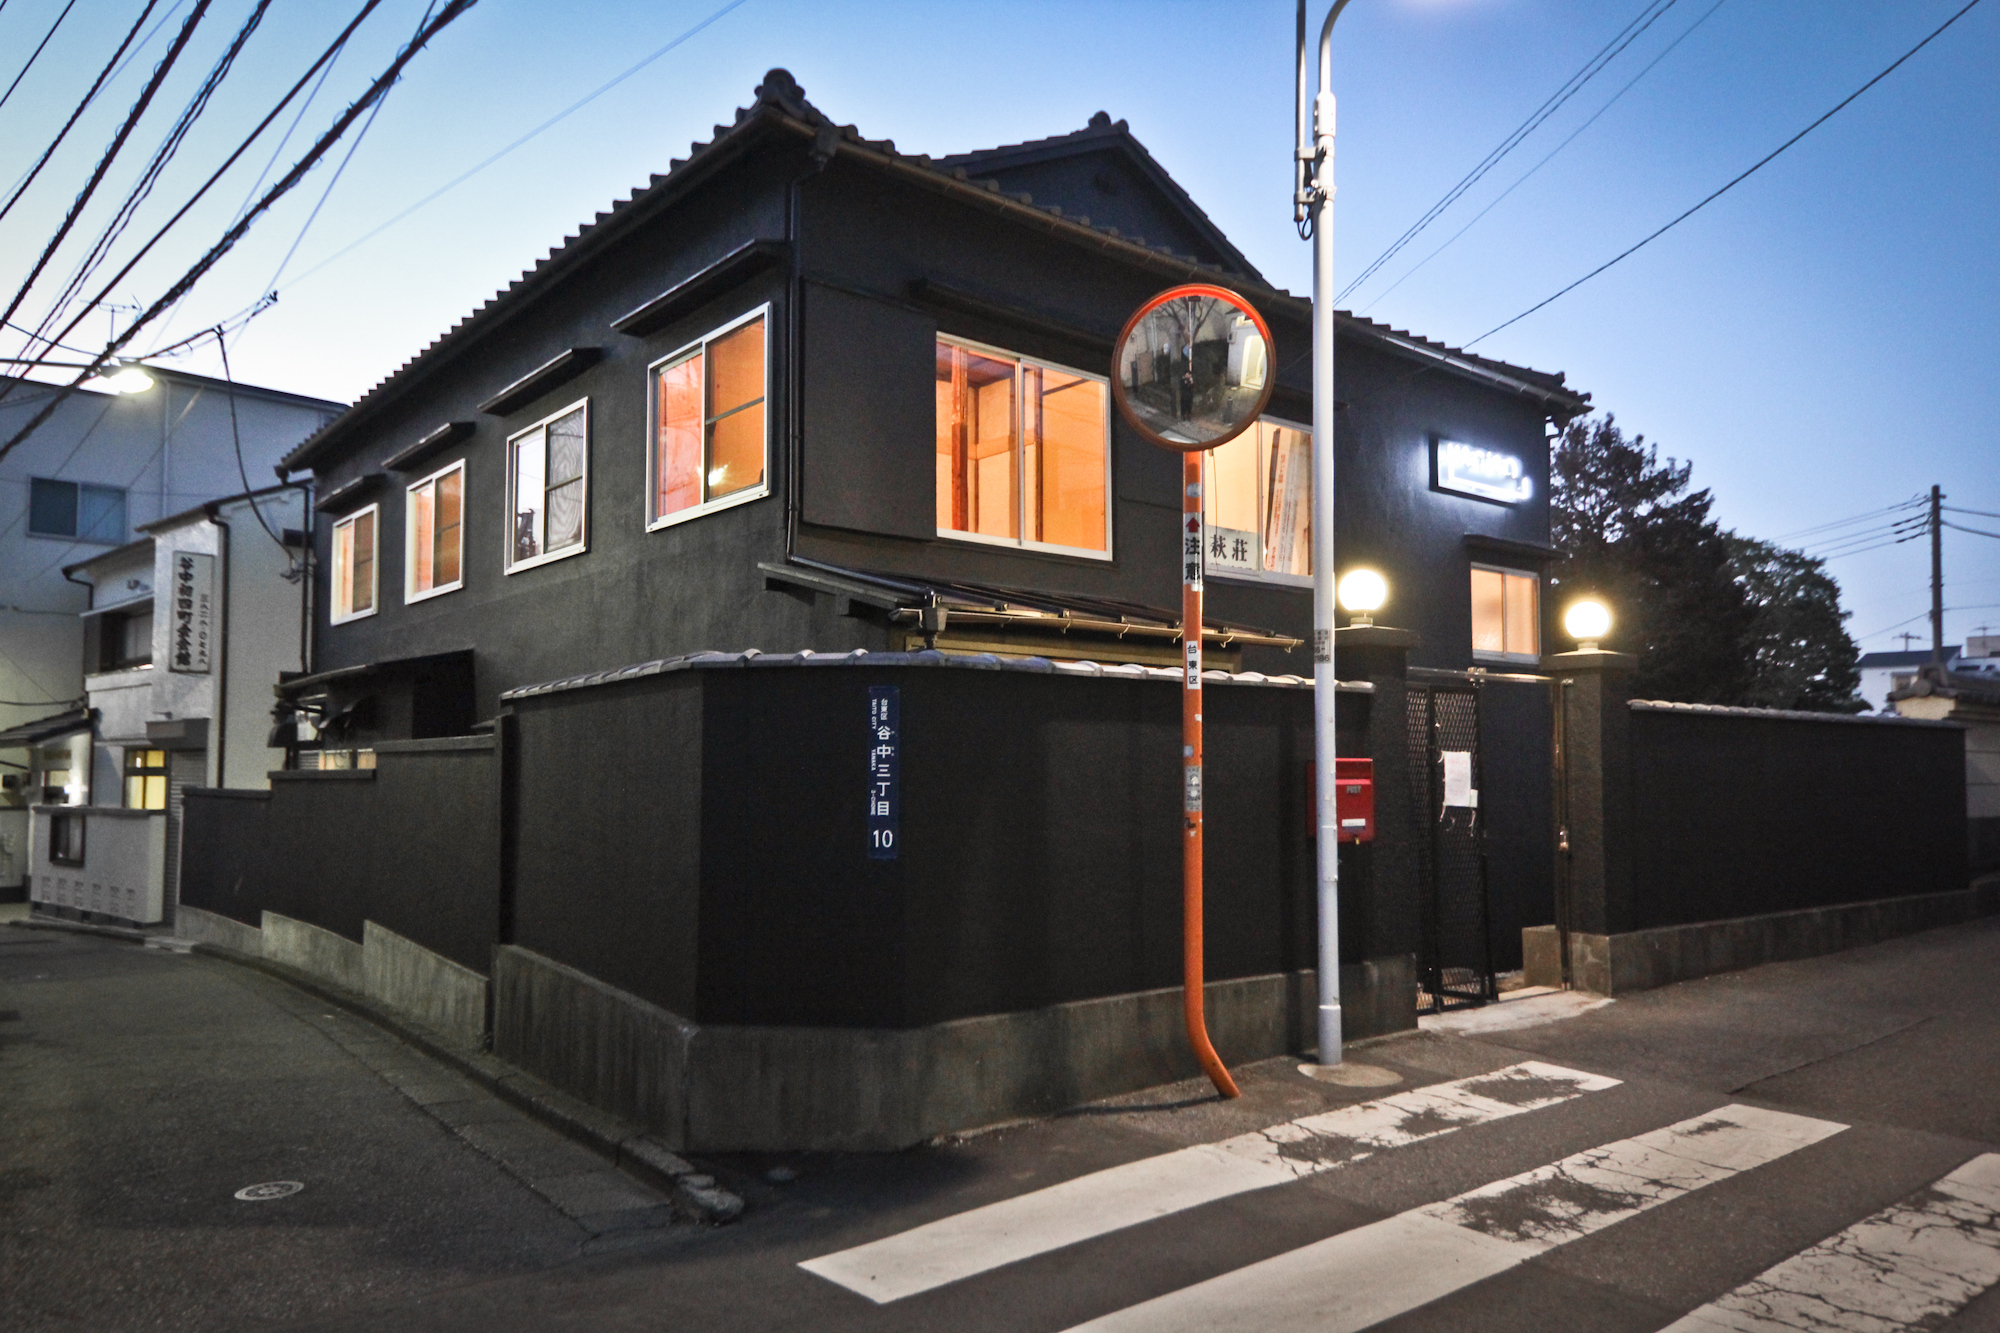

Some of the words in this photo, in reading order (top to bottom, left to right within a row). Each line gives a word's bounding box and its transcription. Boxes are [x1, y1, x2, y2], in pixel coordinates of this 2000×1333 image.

[1185, 536, 1201, 580] 注意
[1210, 534, 1248, 562] 萩荘
[1187, 645, 1198, 685] 台東区
[876, 725, 892, 816] 谷中三丁目
[872, 829, 894, 849] 10
